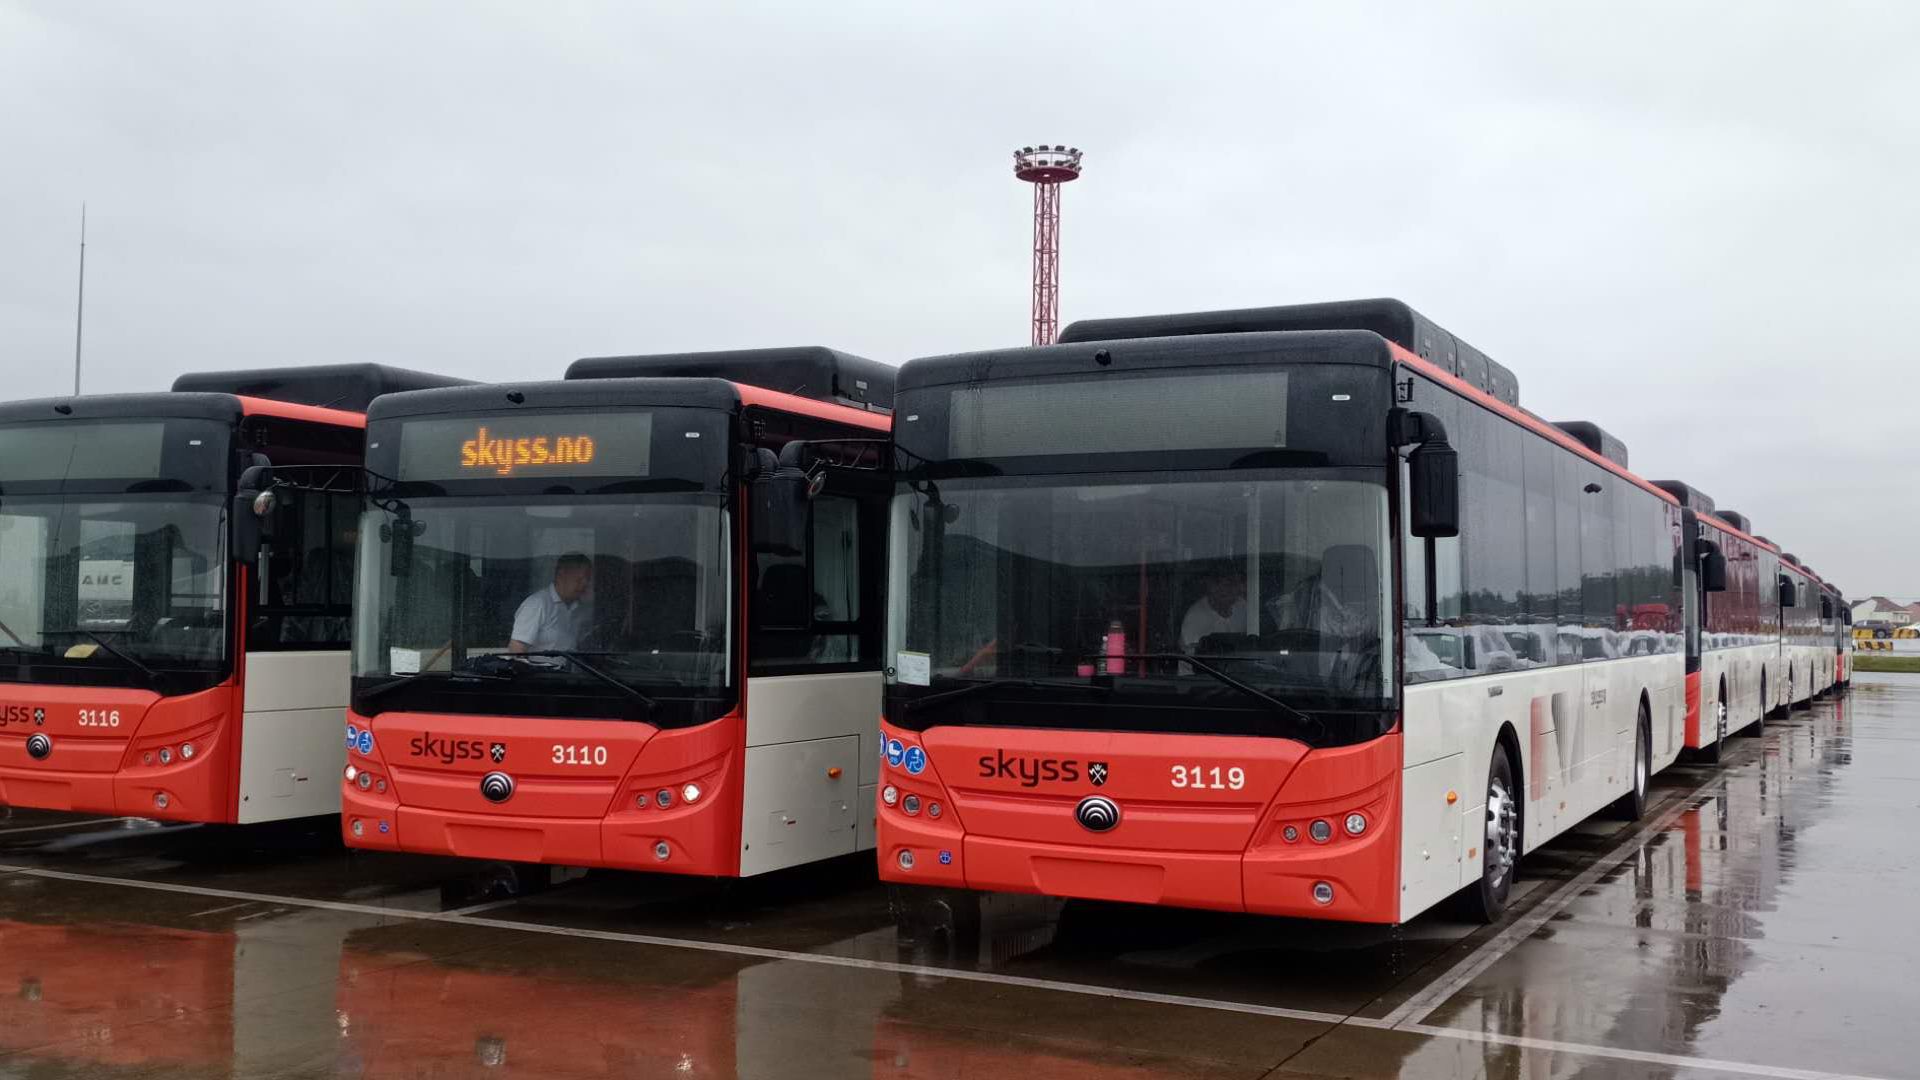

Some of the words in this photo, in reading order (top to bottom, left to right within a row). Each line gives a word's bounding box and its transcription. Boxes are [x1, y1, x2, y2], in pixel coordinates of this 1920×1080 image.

[461, 427, 593, 474] skyss.no
[79, 709, 119, 727] 3116
[410, 731, 484, 764] skyss
[552, 744, 607, 765] 3110
[979, 749, 1079, 787] skyss
[1171, 765, 1245, 789] 3119
